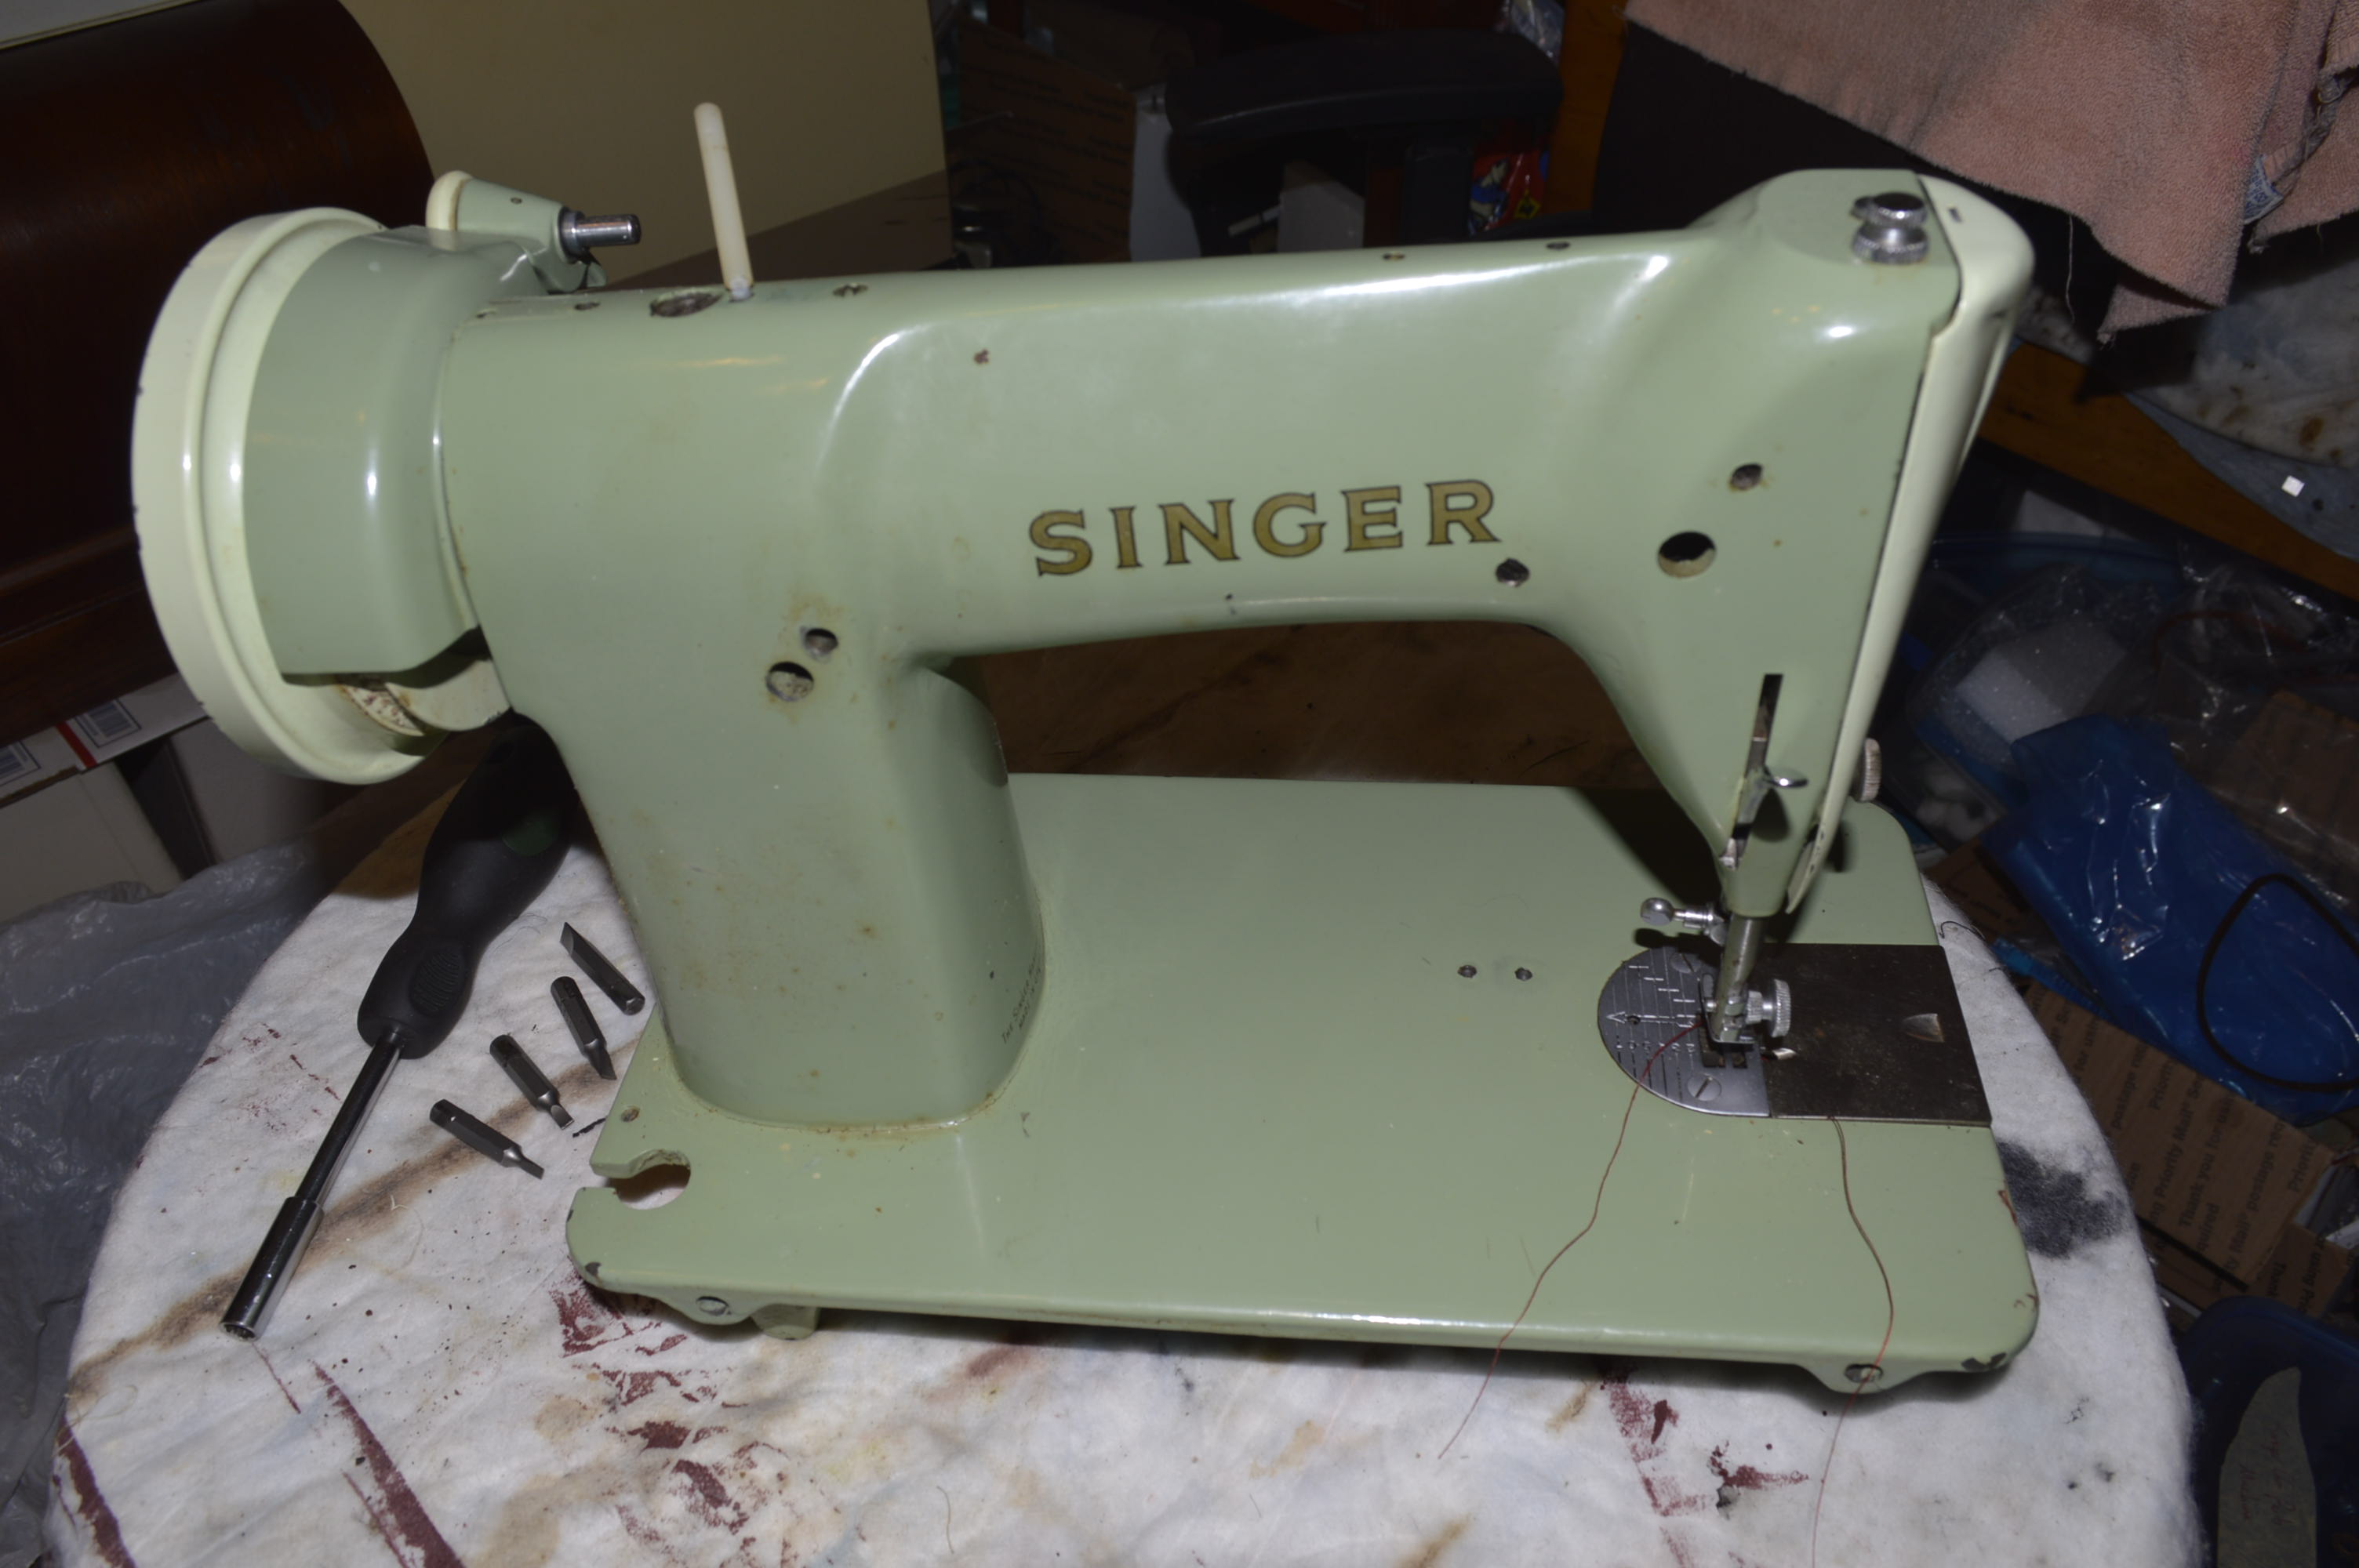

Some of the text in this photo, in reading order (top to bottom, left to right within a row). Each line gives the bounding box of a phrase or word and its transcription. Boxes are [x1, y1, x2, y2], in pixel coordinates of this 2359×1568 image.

[1029, 479, 1502, 577] SINGER
[2109, 1070, 2138, 1130] postage
[2205, 1124, 2223, 1149] for
[2154, 1142, 2182, 1198] Priority
[2197, 1152, 2215, 1181] you
[2245, 1150, 2274, 1211] postage
[2178, 1179, 2205, 1229] Thank
